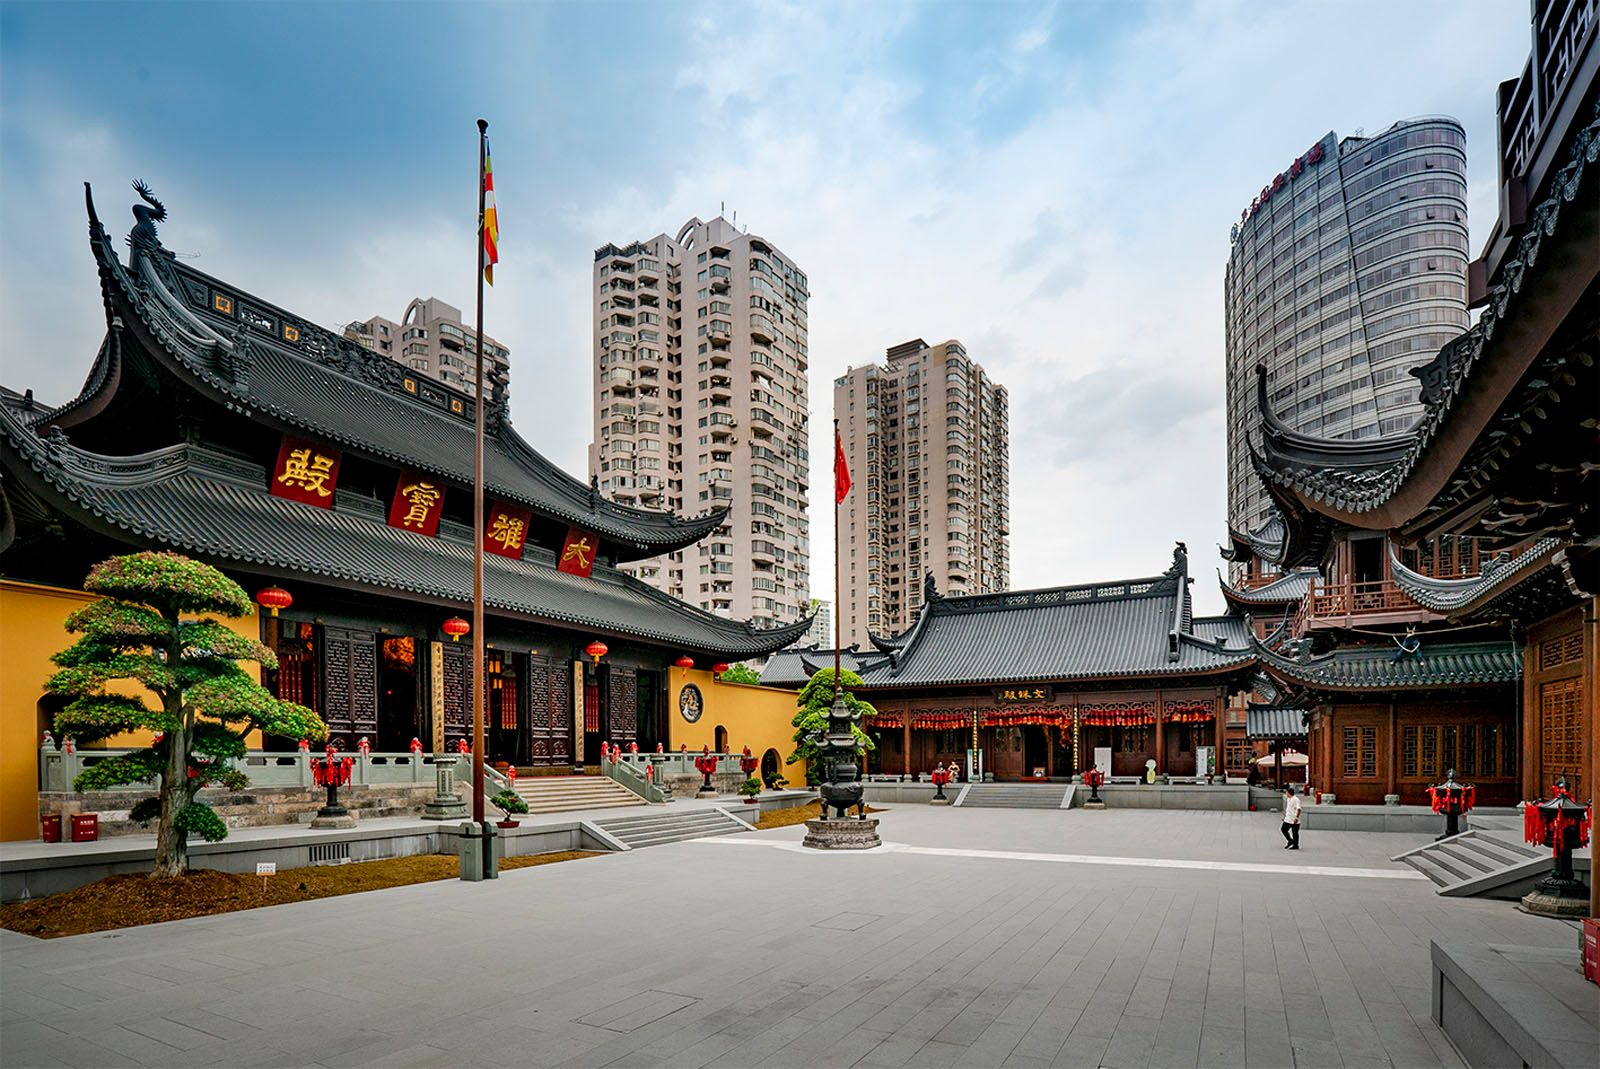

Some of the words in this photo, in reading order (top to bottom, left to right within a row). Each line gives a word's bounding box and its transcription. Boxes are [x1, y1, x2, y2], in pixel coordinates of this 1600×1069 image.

[277, 448, 334, 497] 殿
[402, 482, 440, 528] 寶
[487, 513, 524, 550] 雄
[562, 537, 591, 569] 大
